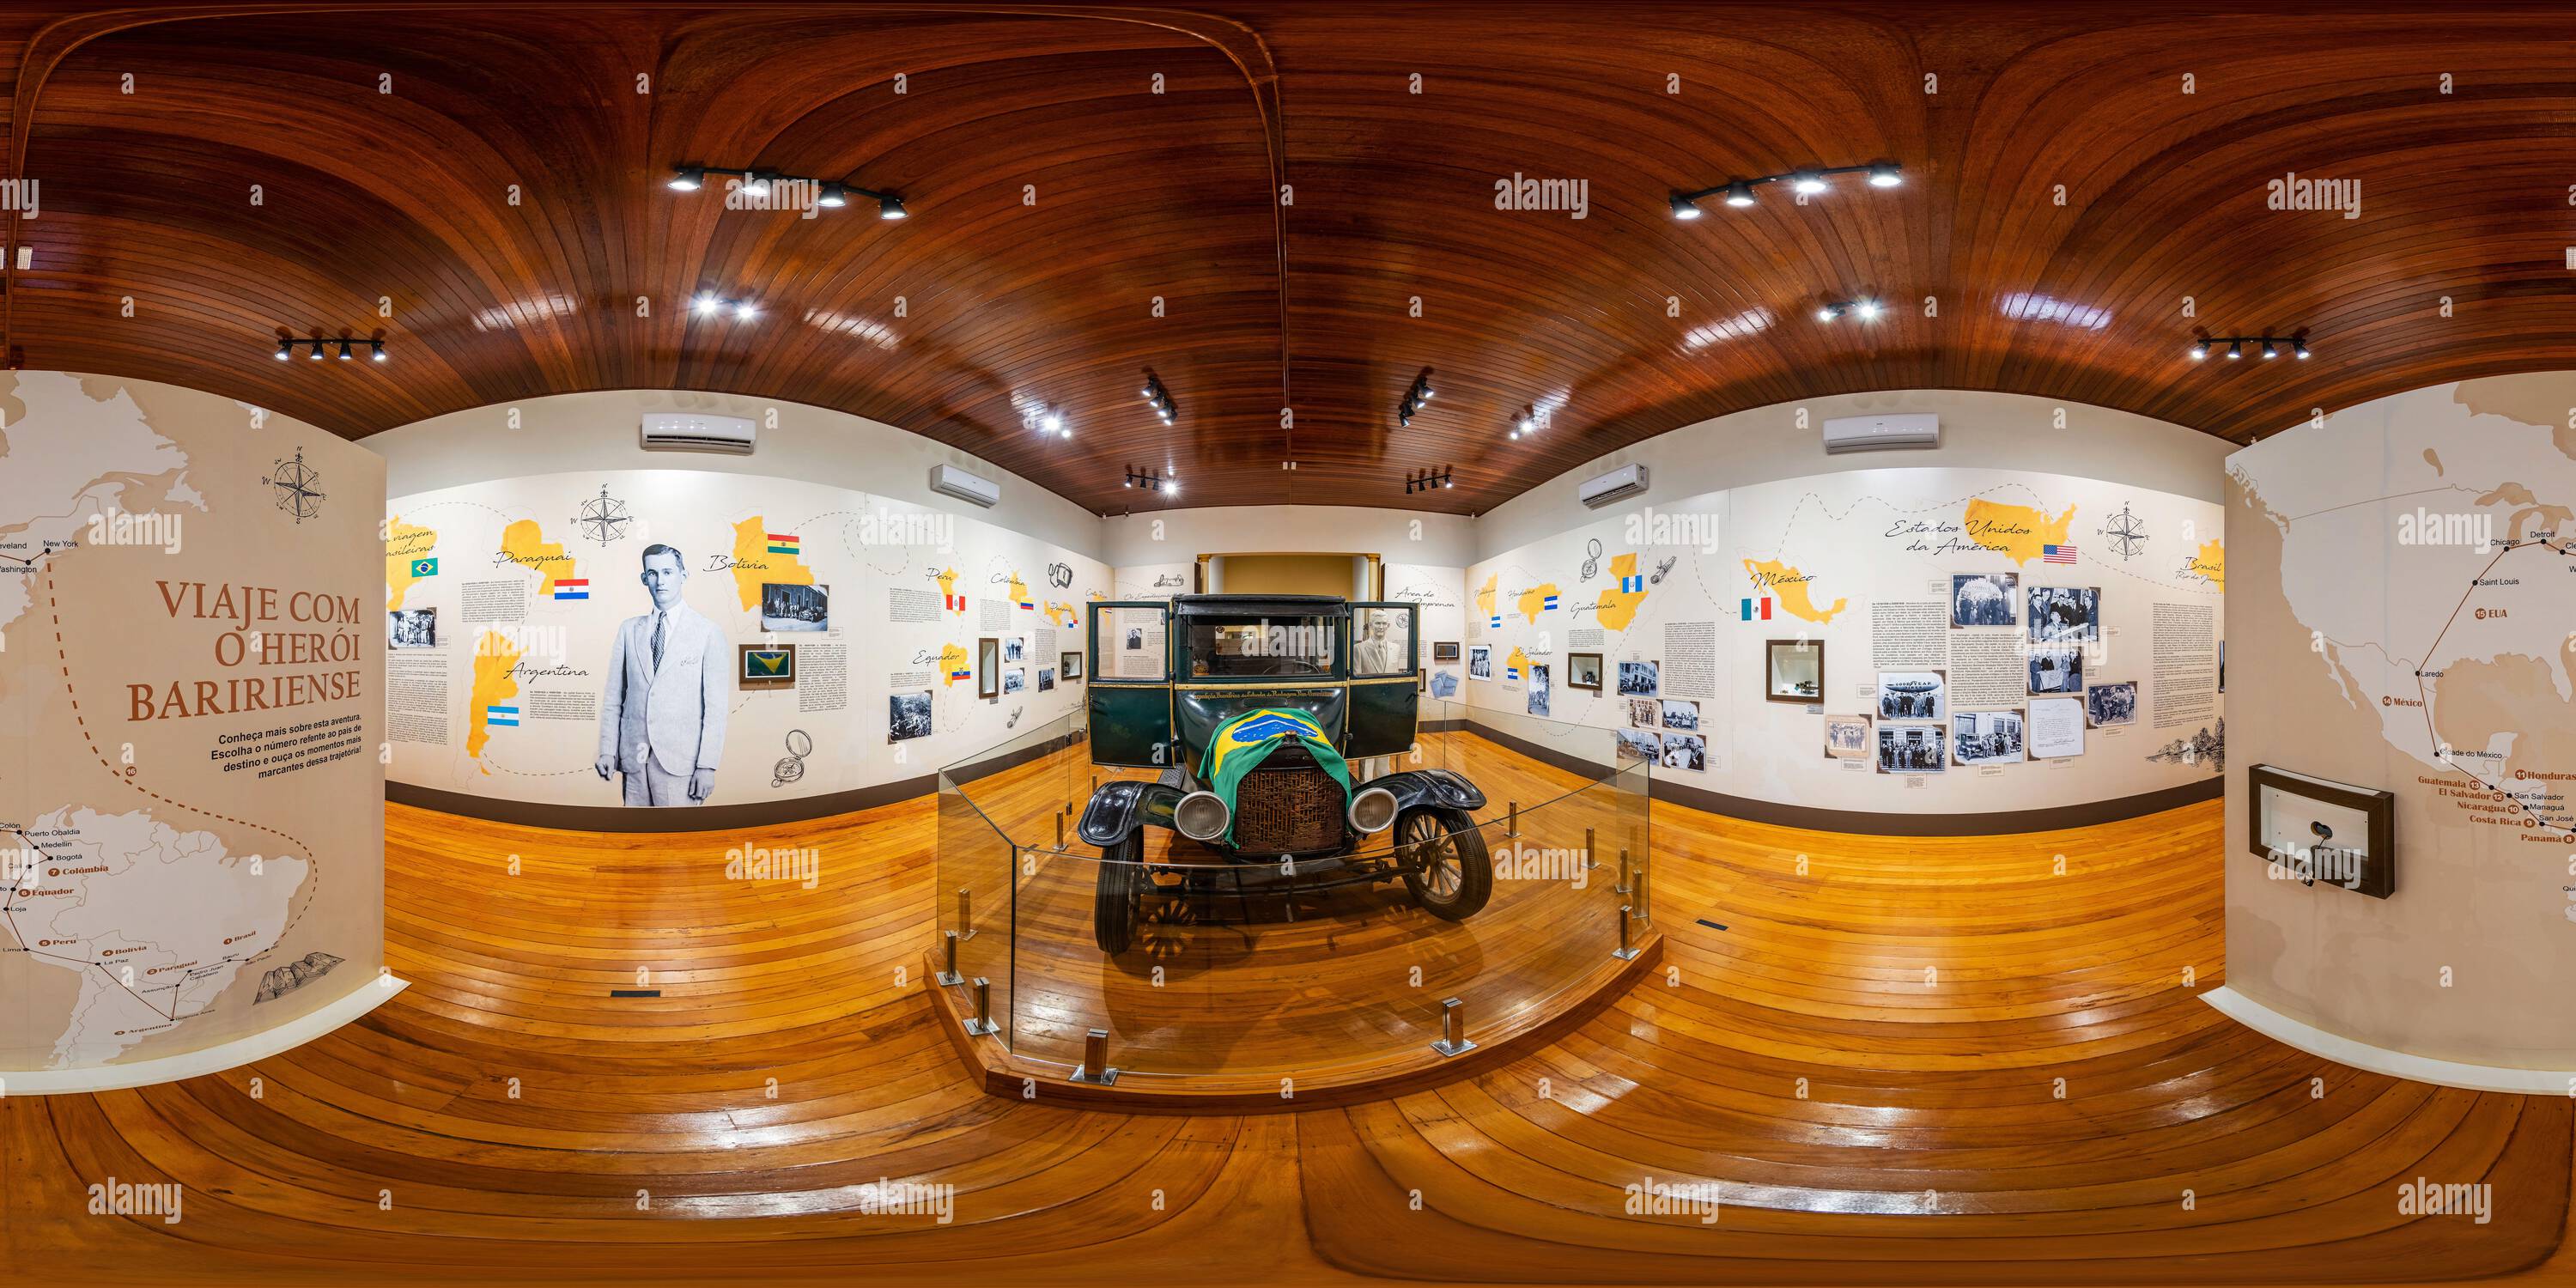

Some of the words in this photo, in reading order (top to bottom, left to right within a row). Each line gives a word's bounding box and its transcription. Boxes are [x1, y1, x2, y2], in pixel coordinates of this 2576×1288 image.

[1885, 519, 1959, 537] Estados
[1965, 519, 2032, 535] Unidos
[1906, 539, 1924, 551] da
[1933, 537, 2011, 556] América
[2490, 538, 2520, 548] Chicago
[492, 550, 572, 570] Paraguai
[702, 555, 769, 573] Bolívia
[2180, 556, 2222, 572] Brasil
[0, 566, 37, 574] ashington
[926, 568, 953, 581] Peru
[2175, 570, 2190, 580] Rio
[1750, 572, 1817, 589] México
[2479, 578, 2498, 586] Saint
[155, 580, 278, 631] VIAJE
[289, 591, 361, 624] COM
[1570, 600, 1617, 619] Guatemala
[215, 632, 246, 667] O
[259, 629, 361, 665] HERÓI
[913, 650, 959, 667] Equador
[503, 661, 590, 684] Argentina
[127, 671, 361, 722] BARIRIENSE
[2393, 698, 2422, 708] México
[218, 731, 263, 744] Conheça
[265, 726, 287, 738] mais
[289, 722, 313, 734] sobre
[313, 719, 330, 729] esta
[331, 714, 361, 726] aventura.
[211, 746, 252, 760] Escolha
[264, 738, 298, 752] número
[300, 733, 326, 744] refente
[327, 730, 337, 738] ao
[223, 759, 260, 772] destino
[271, 753, 293, 763] ouça
[307, 740, 344, 756] momentos
[346, 735, 361, 745] mais
[2476, 750, 2502, 759] México
[258, 762, 304, 779] marcantes
[306, 756, 328, 768] dessa
[330, 745, 361, 762] trajetória!
[2418, 776, 2466, 788] Guatemala
[2528, 771, 2576, 781] Honduras
[2450, 789, 2491, 800] Salvador
[2470, 815, 2496, 825] Costa
[2500, 817, 2521, 826] Rica
[63, 866, 109, 875] Colômbia
[234, 931, 256, 942] Brasil
[159, 960, 197, 973] Paraguai
